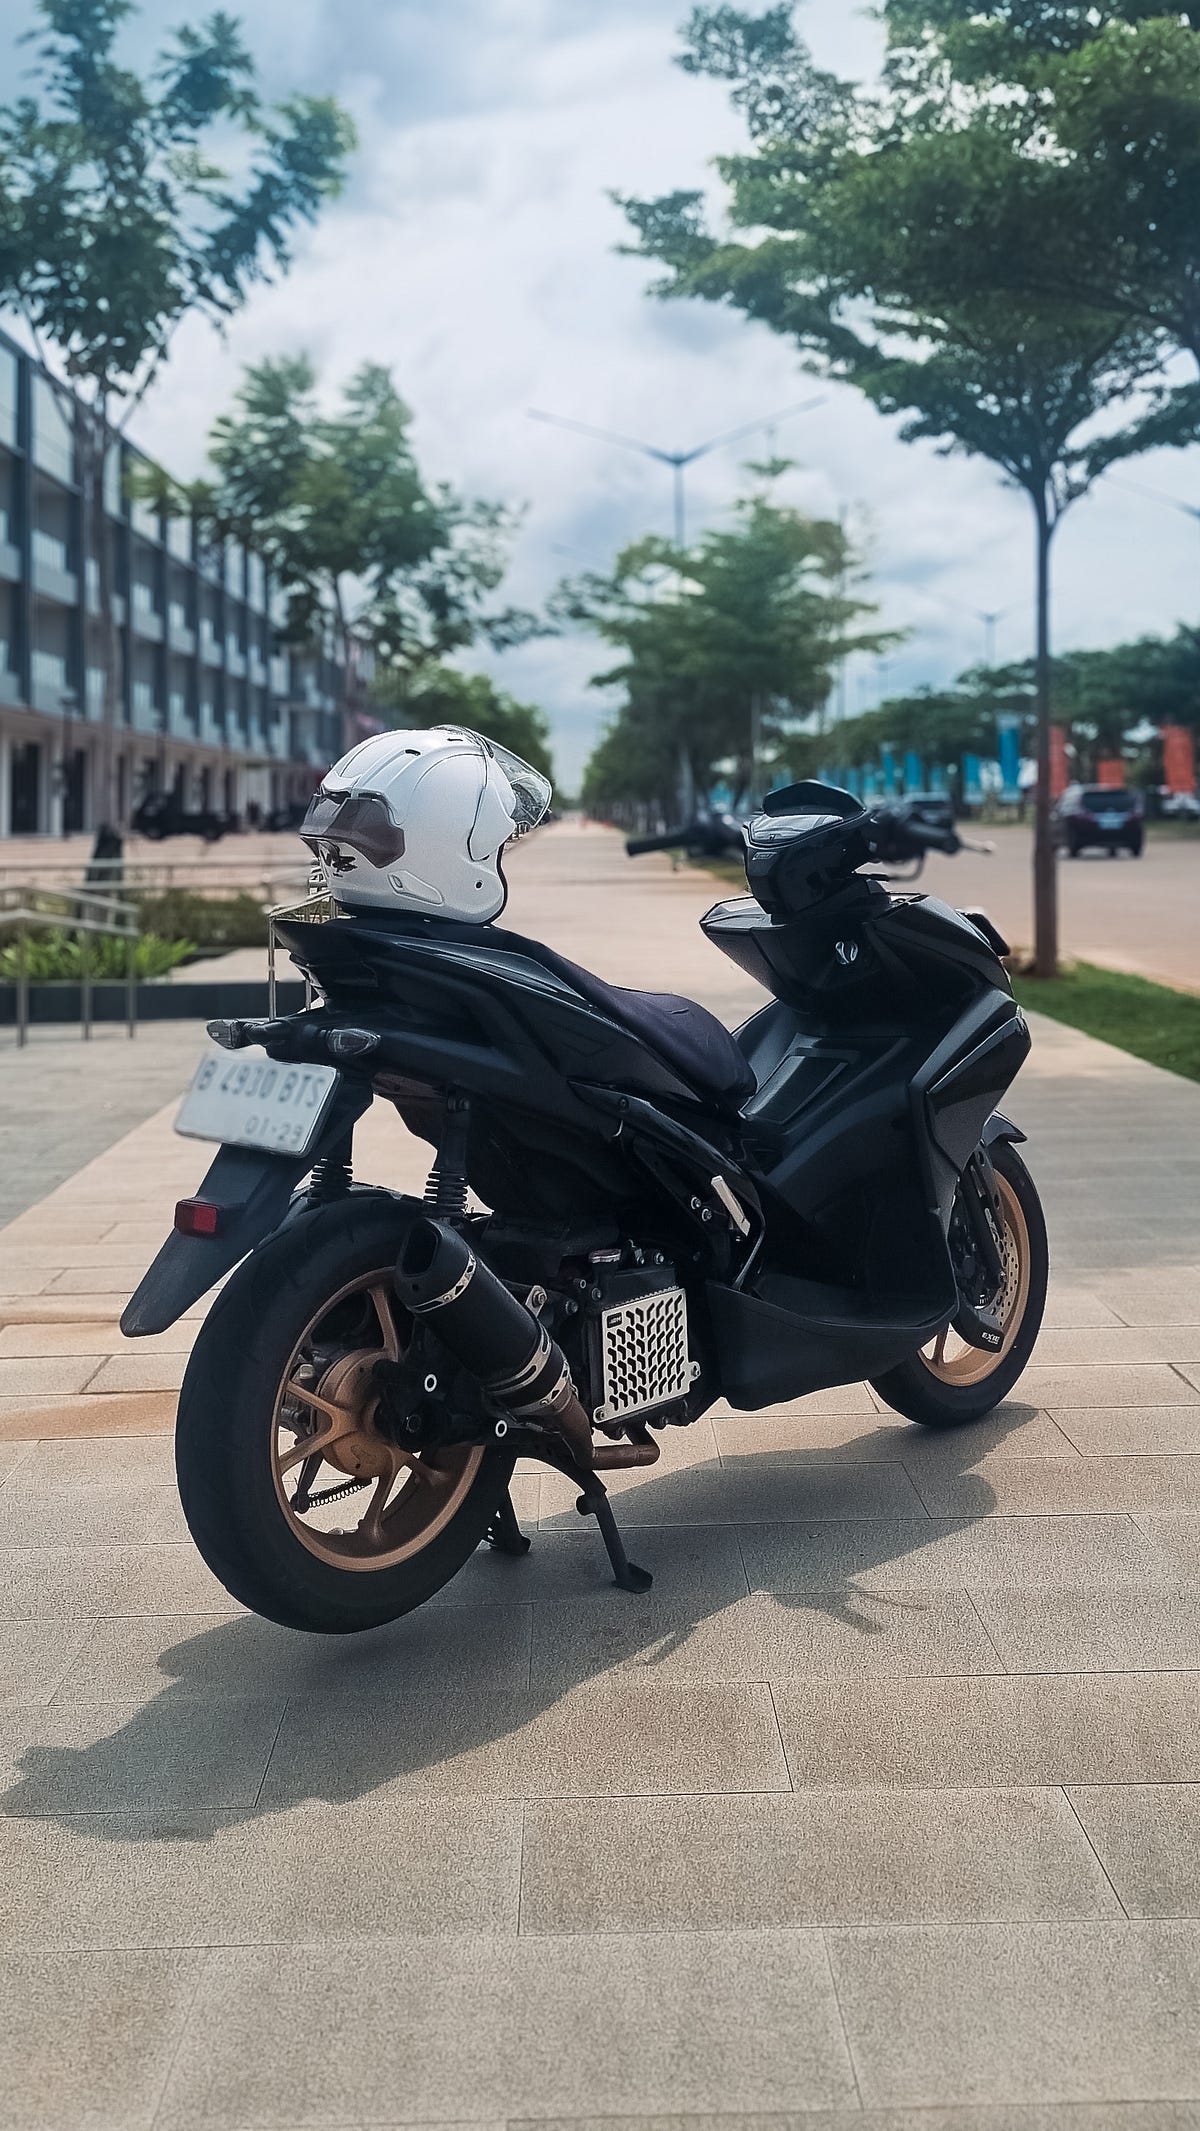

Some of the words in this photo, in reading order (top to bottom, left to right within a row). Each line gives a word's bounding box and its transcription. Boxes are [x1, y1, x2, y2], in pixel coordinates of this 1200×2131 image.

[198, 1060, 218, 1090] B
[221, 1064, 278, 1099] 4930
[278, 1071, 325, 1107] BTS
